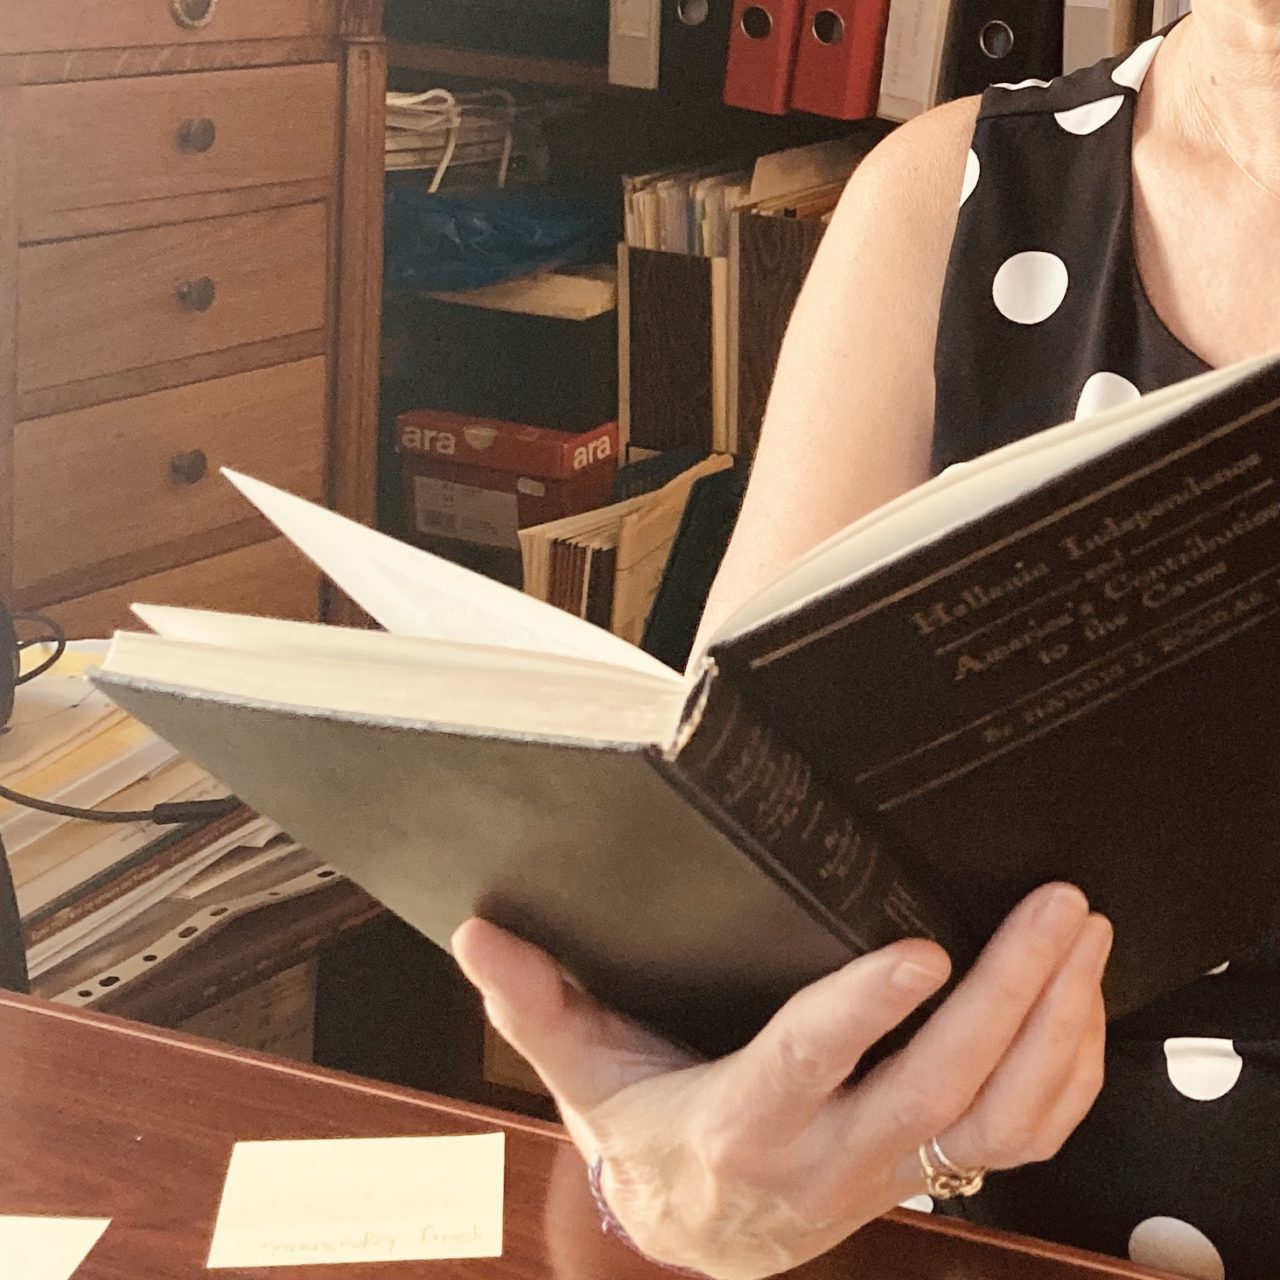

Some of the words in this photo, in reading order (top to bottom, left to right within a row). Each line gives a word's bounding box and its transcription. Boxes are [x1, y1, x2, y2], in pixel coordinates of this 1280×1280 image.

[401, 425, 456, 455] ara
[572, 434, 611, 470] ara
[912, 559, 1051, 636] Hellenic
[1060, 453, 1262, 560] Independence
[1038, 642, 1070, 665] to
[1083, 612, 1129, 642] the
[1141, 561, 1229, 609] Cause
